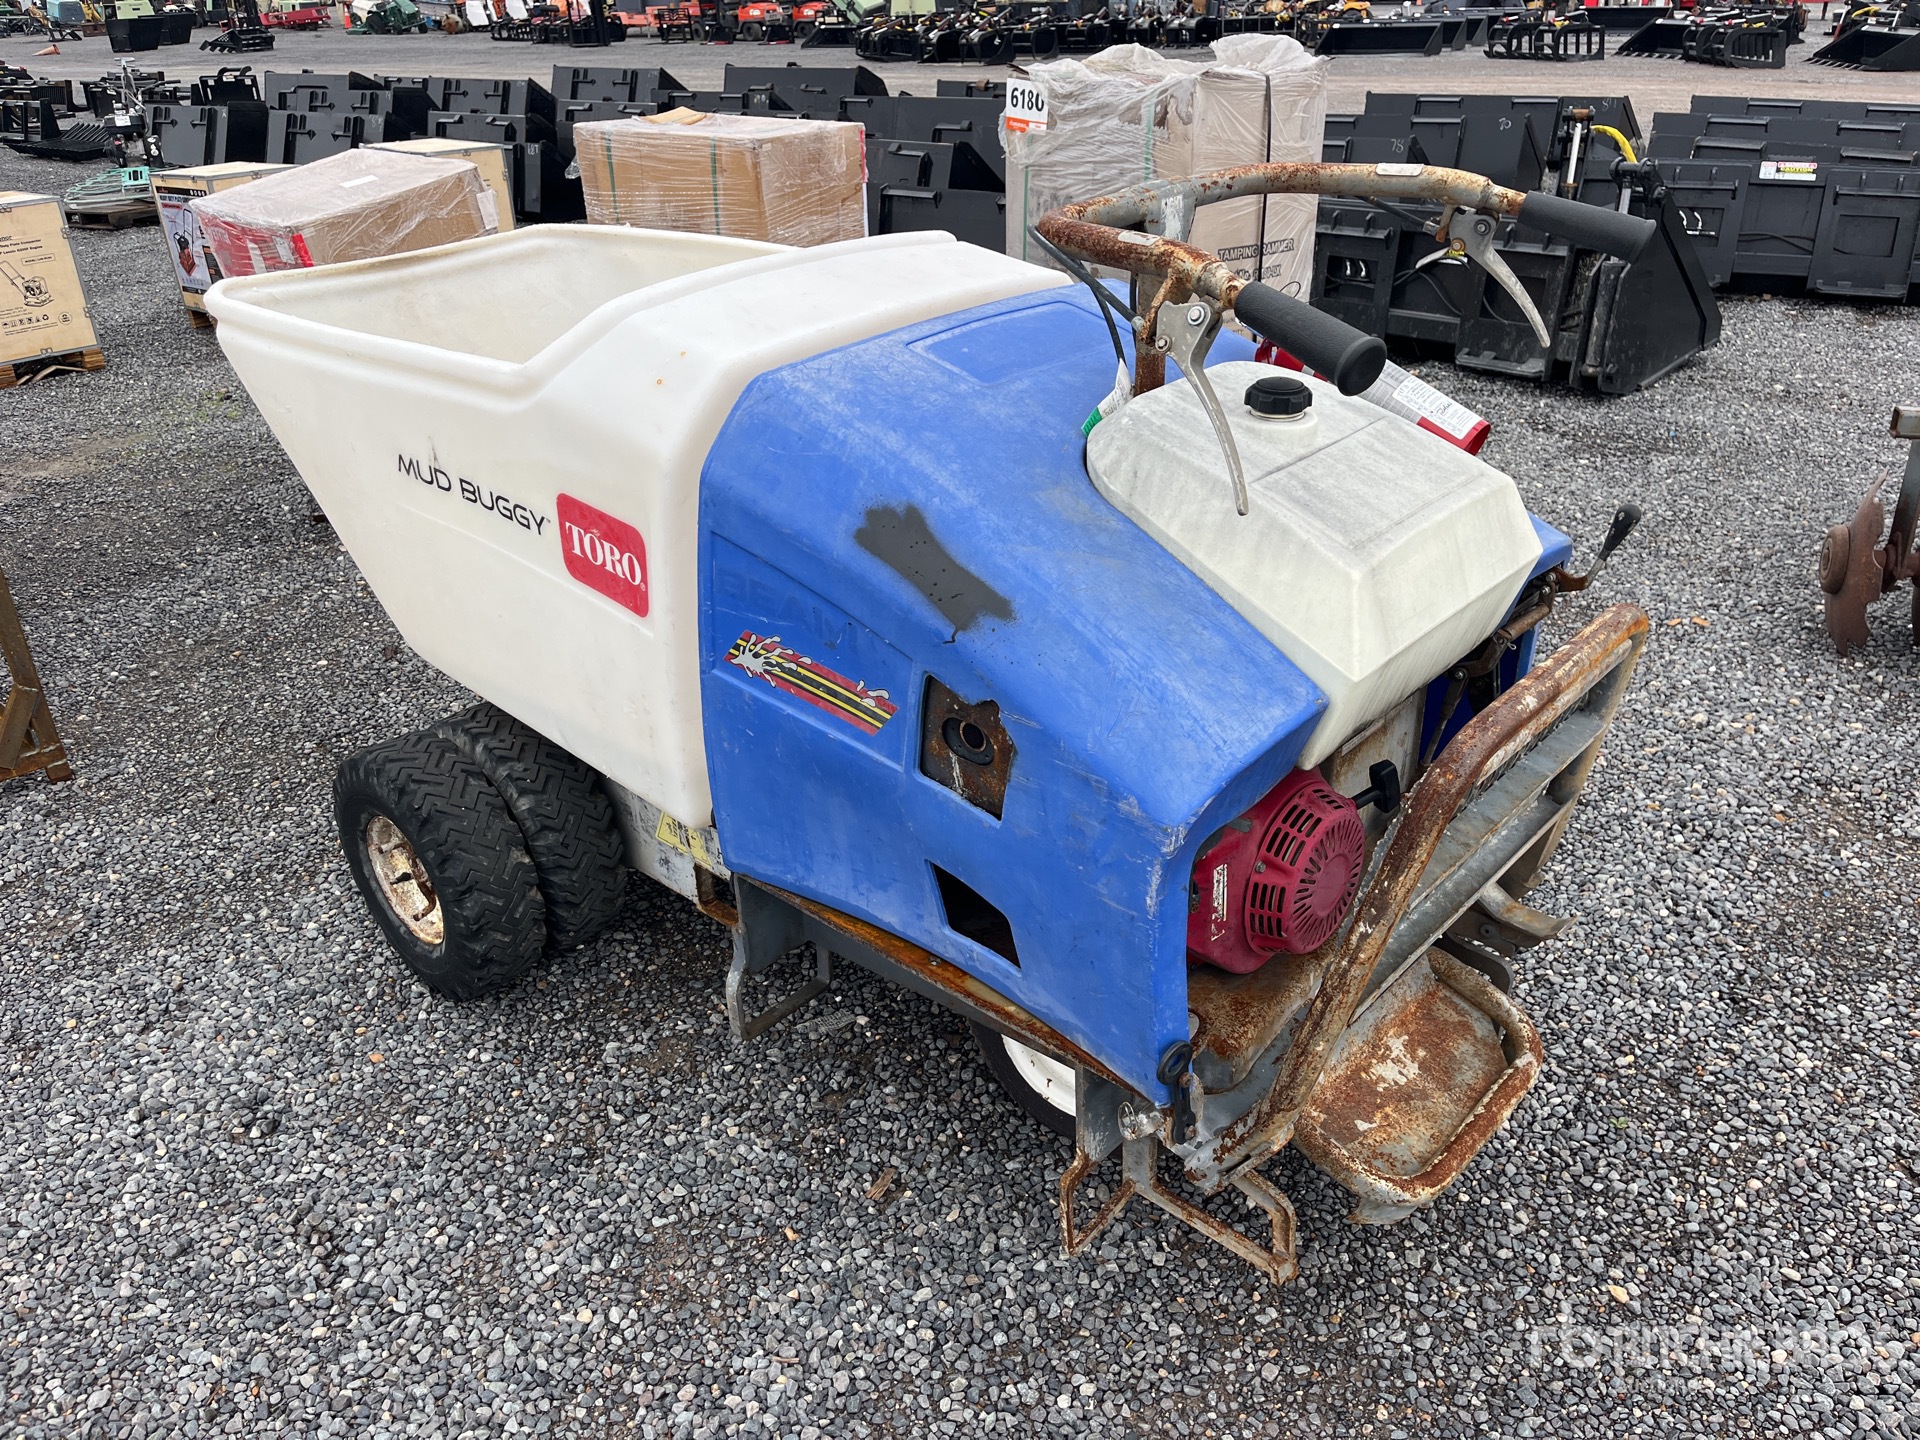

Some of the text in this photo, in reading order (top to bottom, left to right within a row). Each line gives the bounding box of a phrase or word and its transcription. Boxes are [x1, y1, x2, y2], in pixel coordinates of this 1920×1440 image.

[1011, 87, 1045, 112] 6180
[1218, 238, 1295, 261] TAMPING RAMMER
[397, 453, 643, 587] MUD BUGGY TORO
